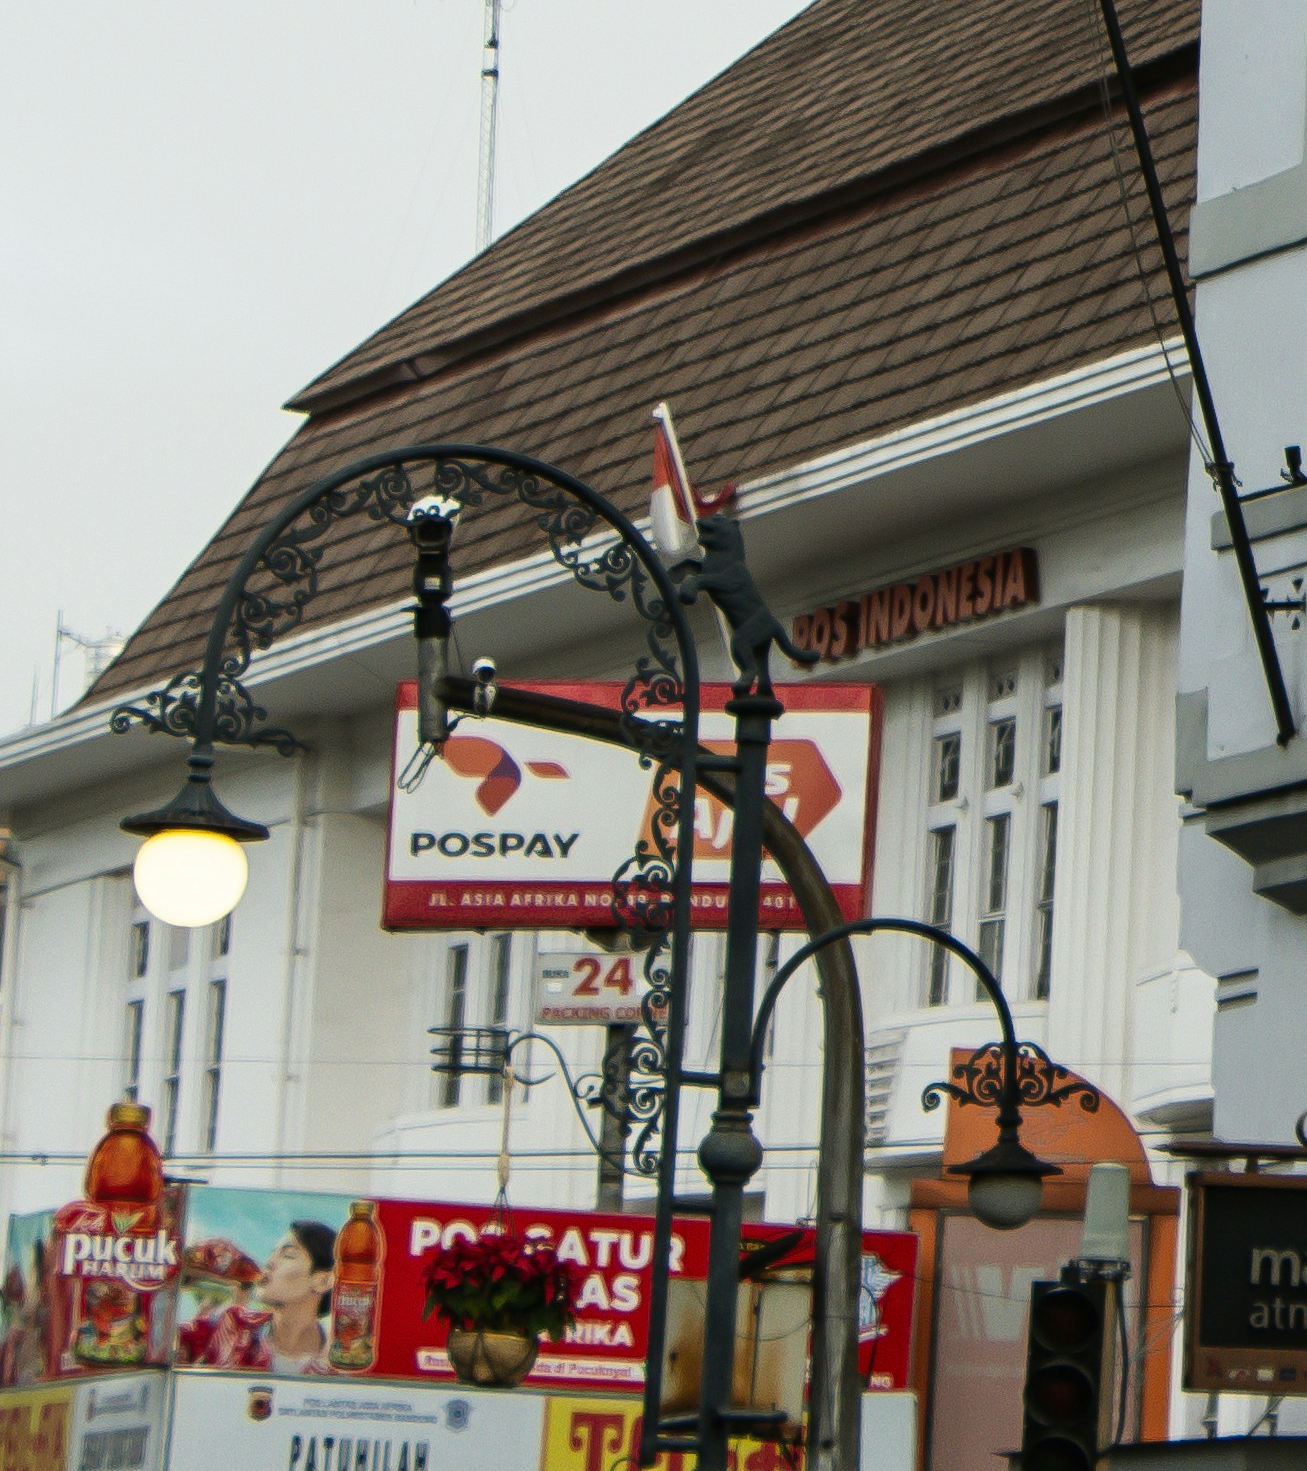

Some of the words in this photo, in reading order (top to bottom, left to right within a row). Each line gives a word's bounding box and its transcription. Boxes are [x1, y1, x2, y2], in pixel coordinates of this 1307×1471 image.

[858, 546, 1036, 650] INDONESIA
[410, 831, 581, 859] POSPAY
[460, 892, 503, 907] ASIA
[509, 893, 578, 908] AFRIKA
[572, 956, 634, 997] 24
[540, 1007, 610, 1021] PACKING
[62, 1229, 178, 1276] pucuk
[81, 1260, 166, 1280] HARUM
